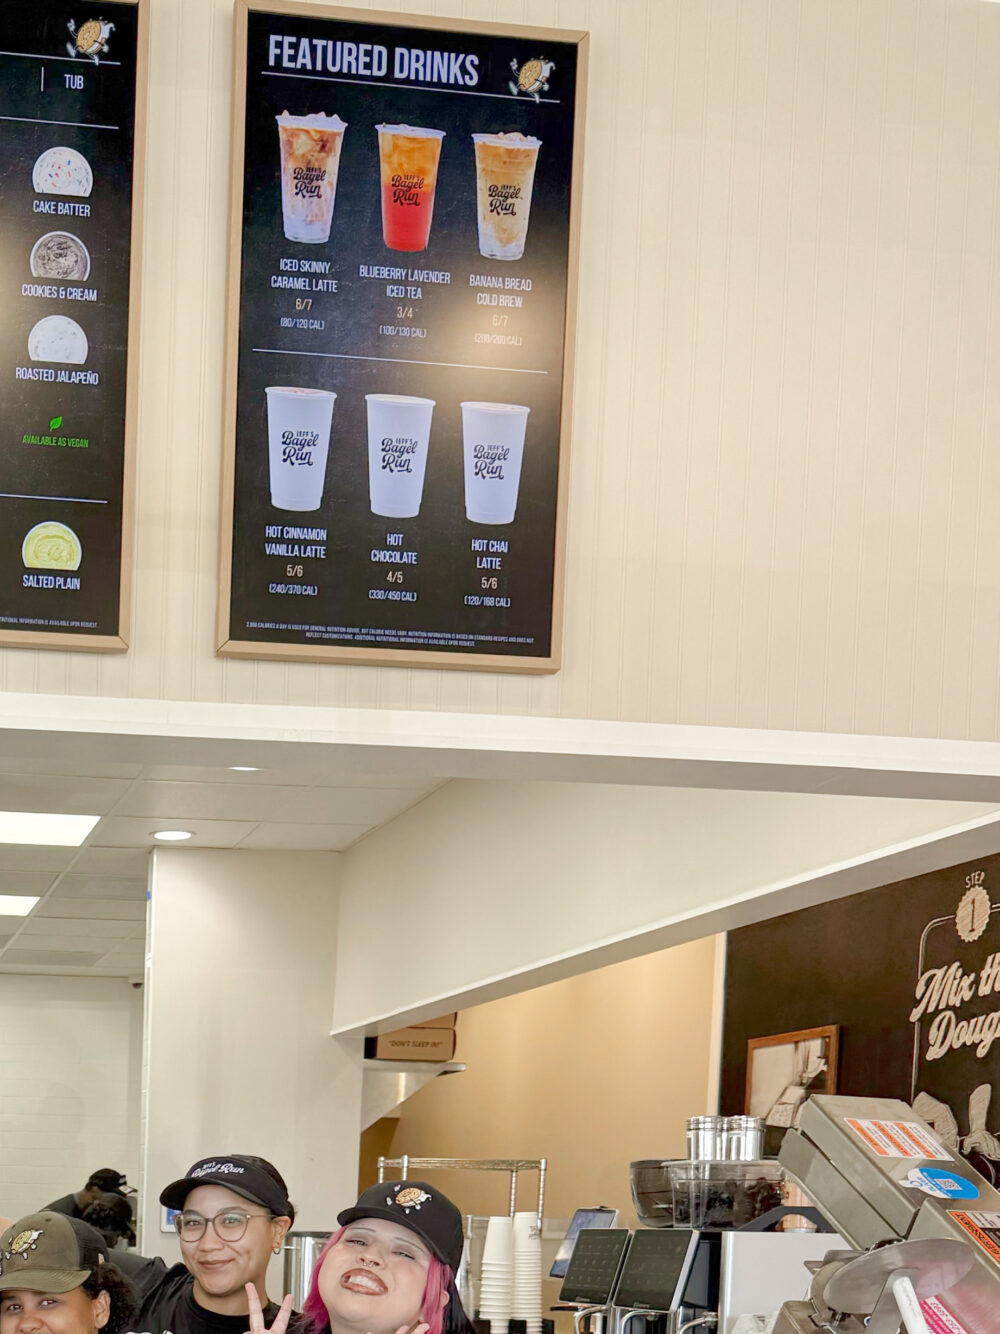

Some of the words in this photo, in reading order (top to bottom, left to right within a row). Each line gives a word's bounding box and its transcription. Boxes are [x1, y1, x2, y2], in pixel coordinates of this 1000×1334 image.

[267, 35, 387, 77] FEATURED
[393, 48, 478, 85] DRINKS
[64, 74, 83, 89] TUB
[293, 167, 326, 184] Bagel
[392, 175, 424, 192] Bagel
[488, 184, 520, 201] Bagel
[34, 201, 56, 213] CAKE
[58, 203, 90, 216] BATTER
[280, 259, 298, 271] ICED
[300, 260, 330, 273] SKINNY
[360, 265, 406, 280] BLUEBERRY
[409, 270, 450, 284] LAVENDER
[271, 276, 311, 290] CARAMEL
[313, 279, 338, 292] LATTE
[470, 275, 504, 289] BANANA
[505, 278, 532, 291] BREAD
[22, 284, 57, 297] COOKIES
[67, 288, 96, 301] CREAM
[387, 285, 404, 297] ICED
[407, 287, 422, 299] TEA
[296, 298, 312, 310] 6/7
[477, 293, 499, 306] COLD
[498, 295, 522, 310] BREW
[397, 307, 412, 318] 3/4
[16, 367, 54, 381] ROASTED
[282, 431, 319, 450] Bagel
[381, 438, 417, 457] Bagel
[474, 445, 509, 464] Bagel
[266, 526, 282, 537] HOT
[284, 527, 326, 540] CINNAMON
[387, 534, 403, 545] HOT
[266, 543, 299, 556] VANILLA
[301, 546, 326, 558] LATTE
[472, 540, 487, 551] HOT
[489, 541, 507, 552] CHAI
[371, 550, 417, 564] CHOCOLATE
[477, 557, 501, 569] LATTE
[287, 565, 303, 576] 5/6
[387, 571, 402, 583] 4/5
[23, 575, 54, 588] SALTED
[56, 577, 80, 589] PLAIN
[482, 577, 497, 589] 5/6
[966, 871, 984, 888] STEP
[968, 898, 976, 932] 1
[909, 961, 975, 1022] Mix
